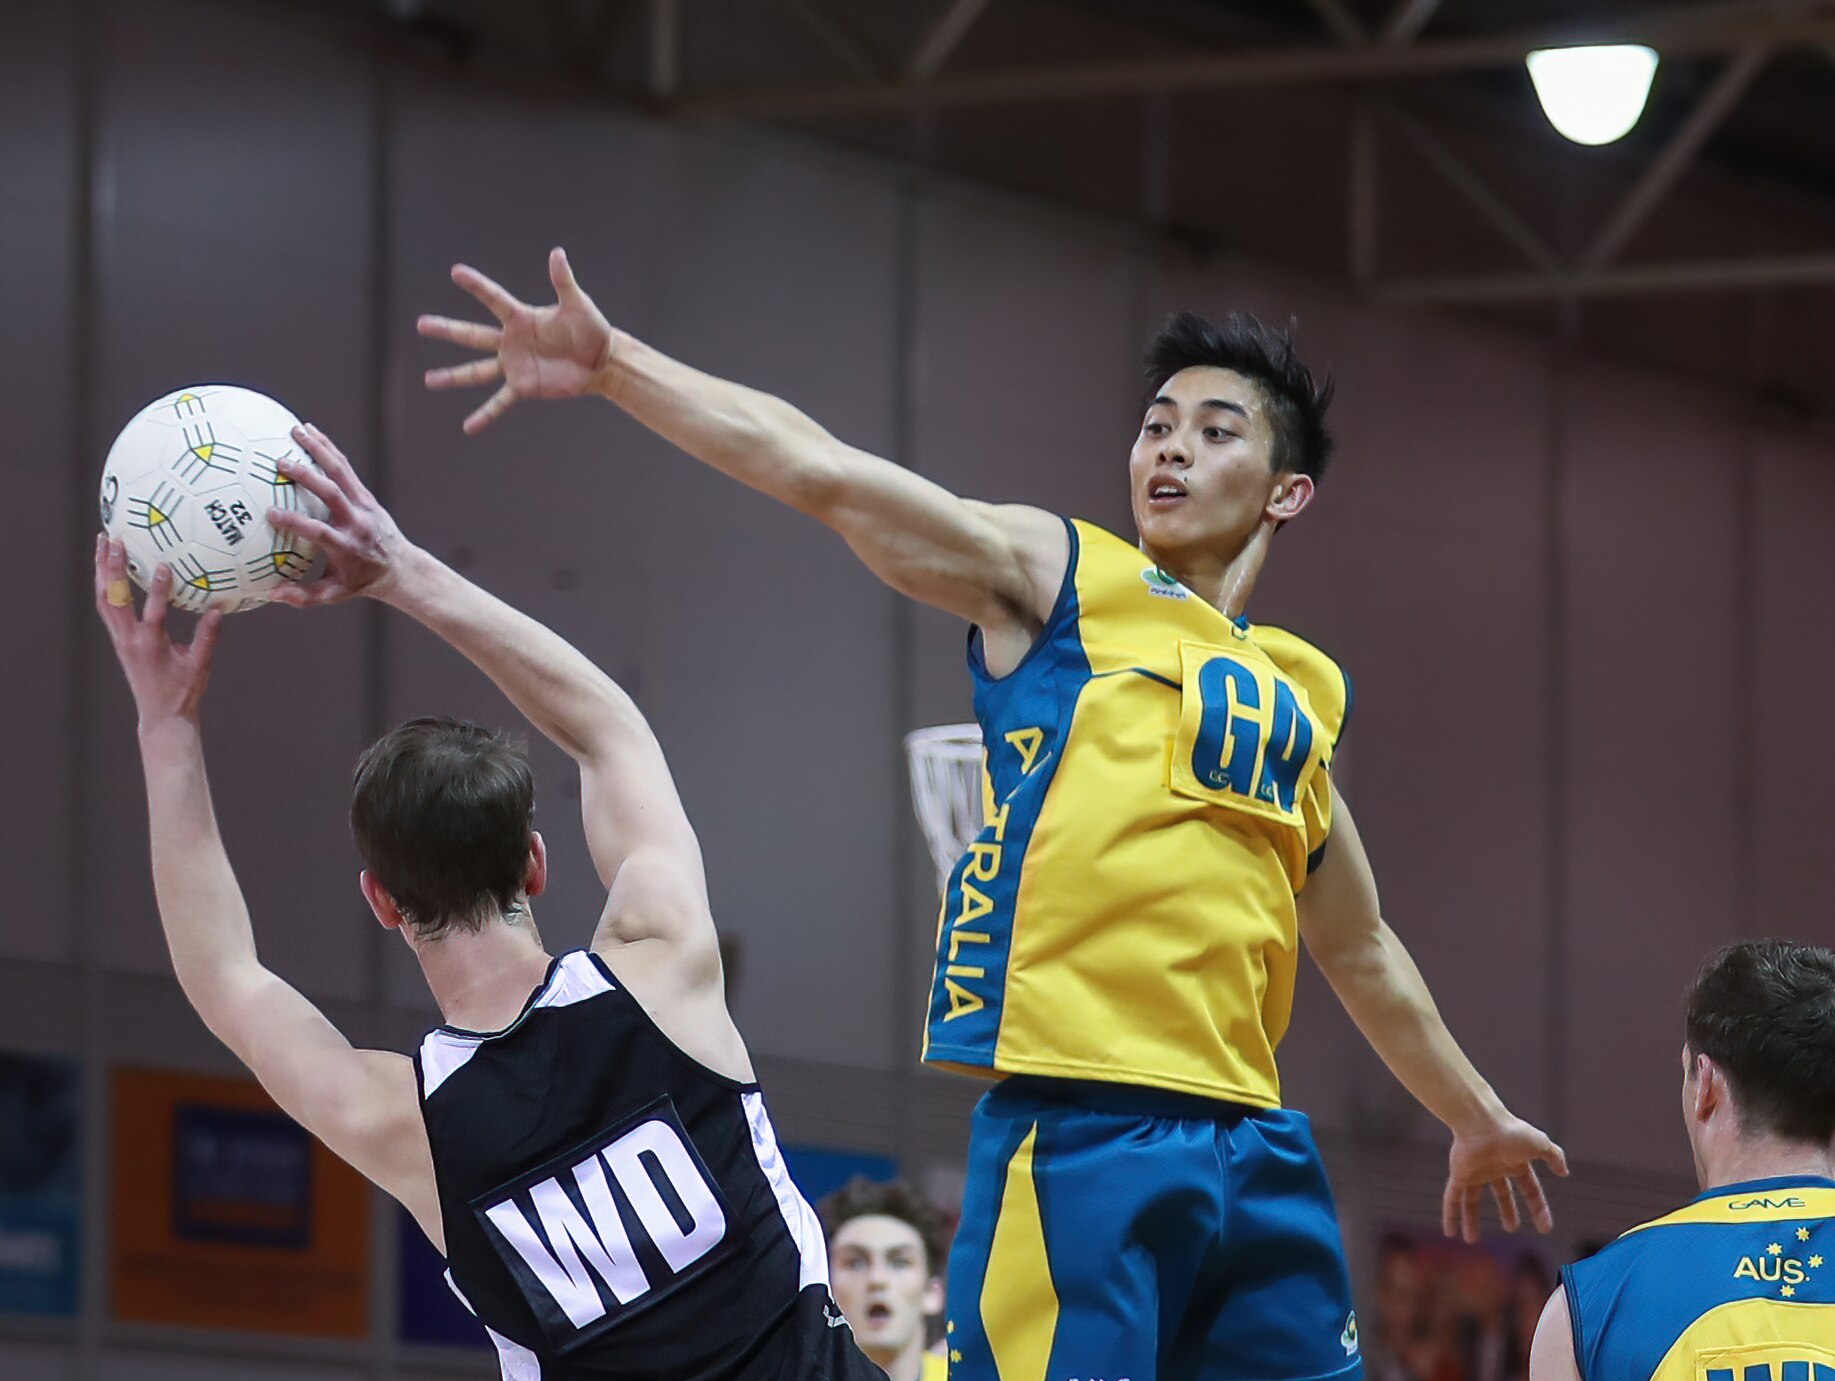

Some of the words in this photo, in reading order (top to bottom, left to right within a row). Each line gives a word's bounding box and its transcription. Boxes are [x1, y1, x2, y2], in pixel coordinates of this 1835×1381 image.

[203, 499, 245, 546] MATCH
[229, 499, 253, 525] 32
[943, 726, 1045, 1023] ATRALIA
[485, 1119, 727, 1330] WD
